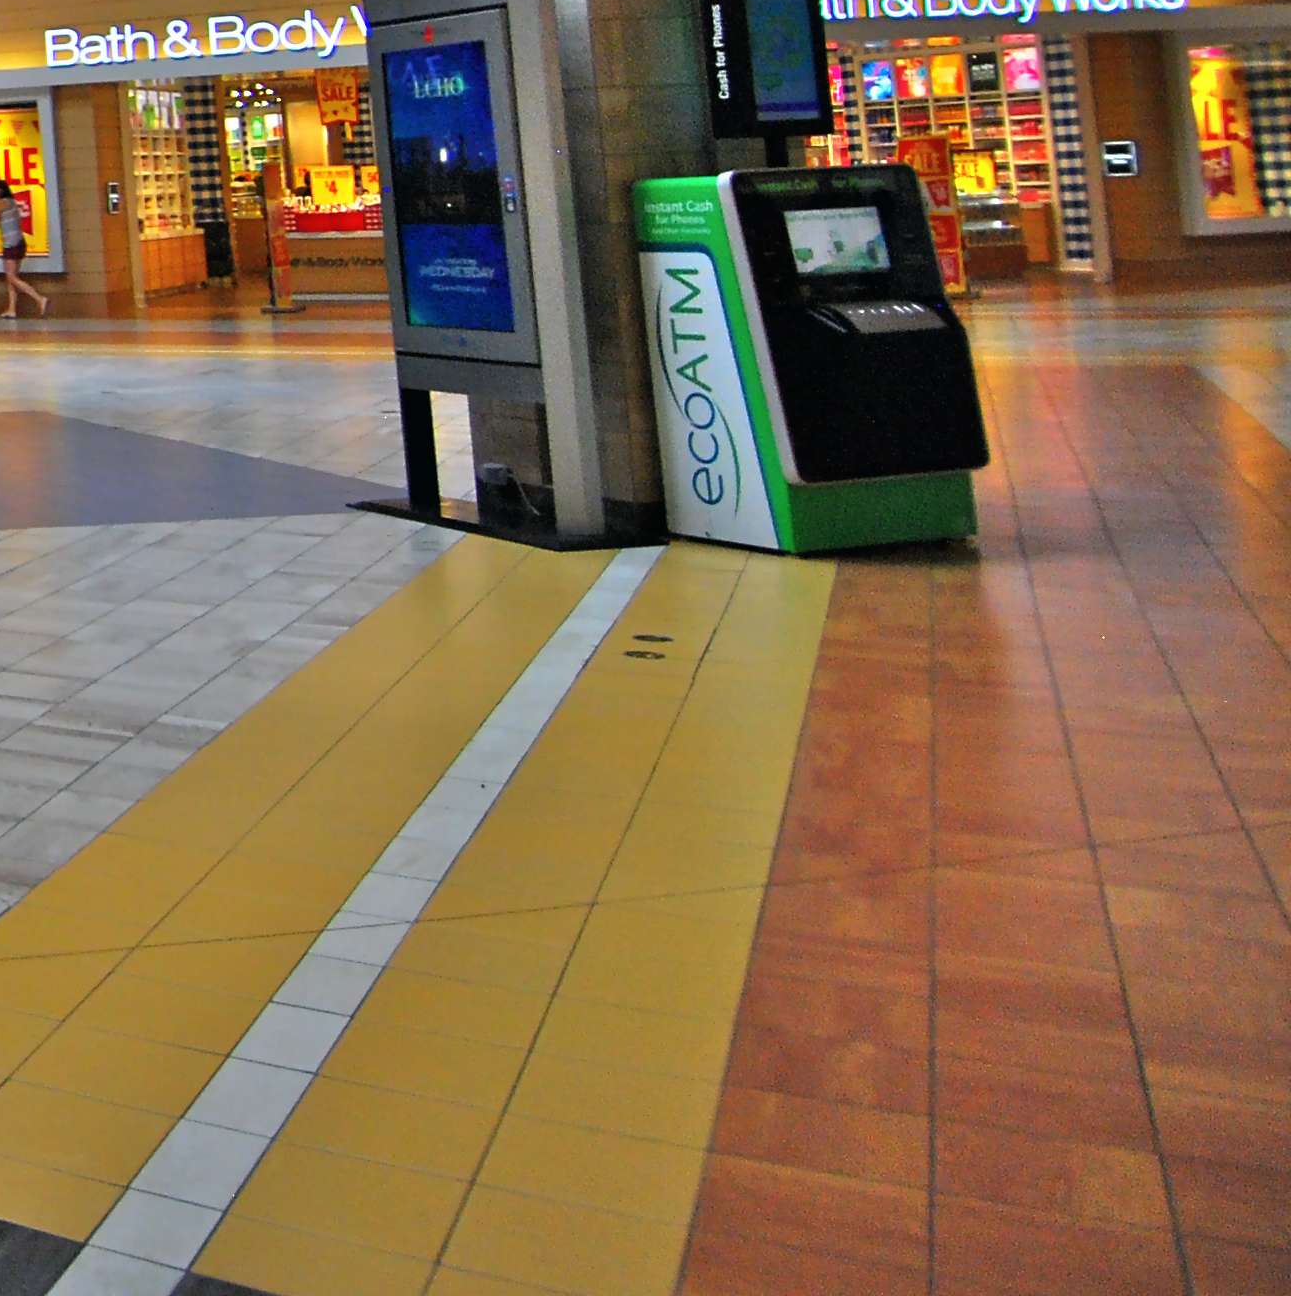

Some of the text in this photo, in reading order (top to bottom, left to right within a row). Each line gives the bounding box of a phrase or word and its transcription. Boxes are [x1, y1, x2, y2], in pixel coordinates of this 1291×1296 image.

[44, 24, 157, 68] Bath
[162, 19, 204, 61] &
[207, 8, 345, 58] Body
[712, 4, 730, 99] Cash for Phones
[322, 87, 354, 102] SALE
[644, 200, 714, 214] Instant Cash
